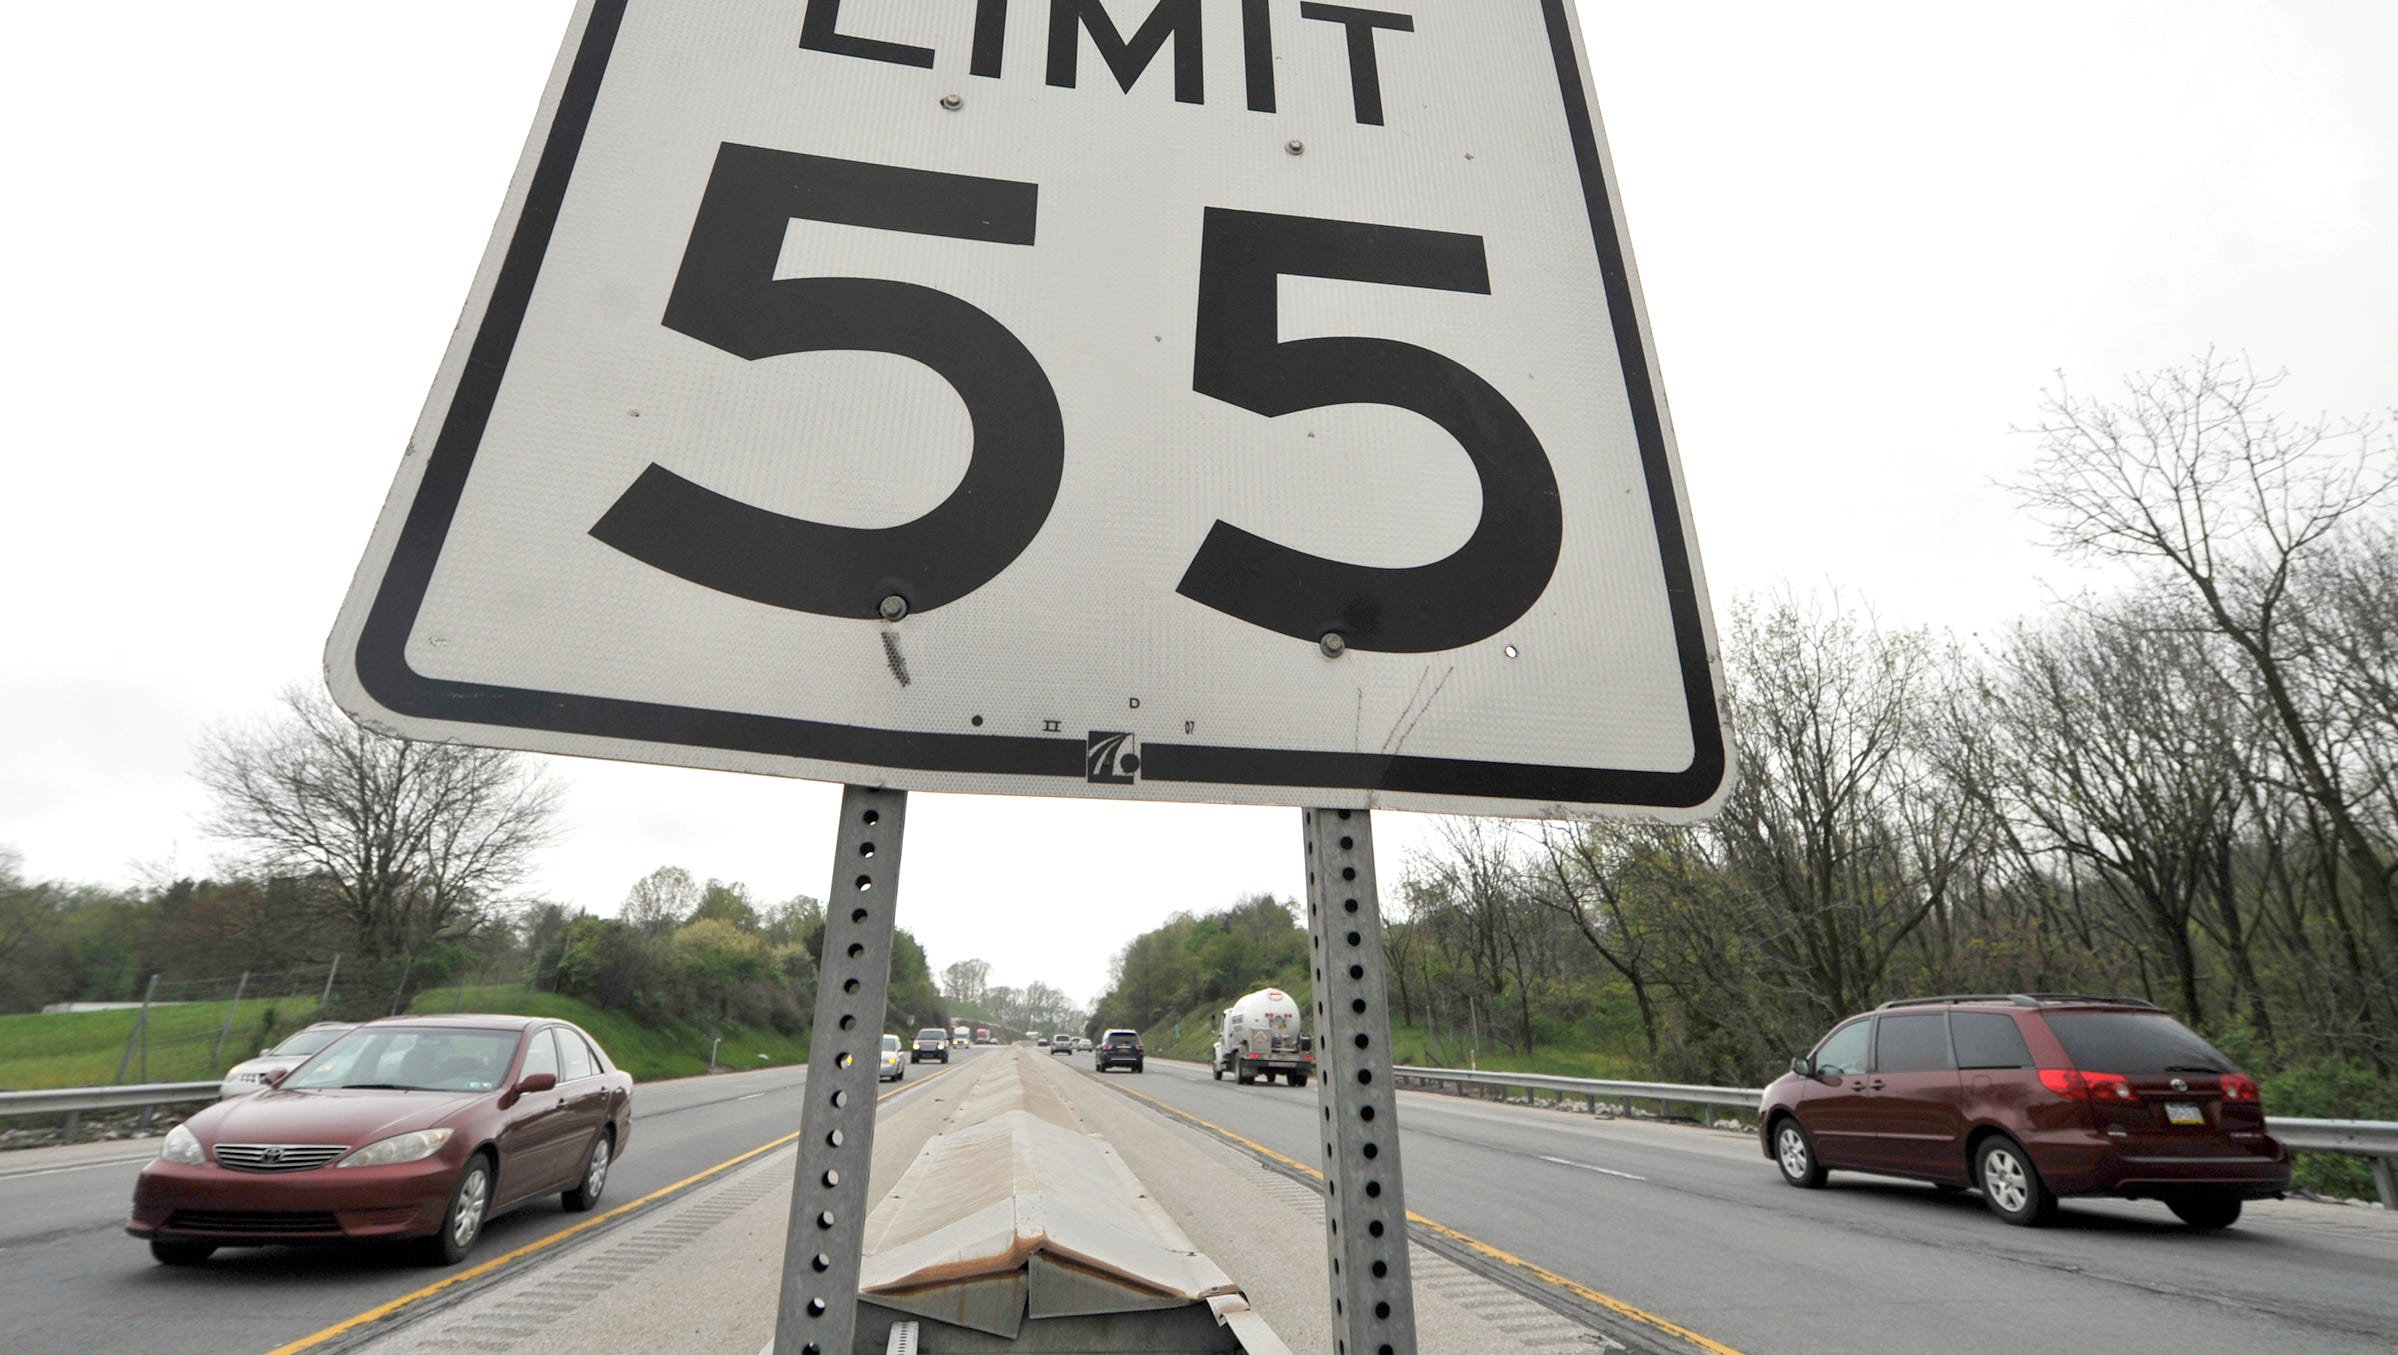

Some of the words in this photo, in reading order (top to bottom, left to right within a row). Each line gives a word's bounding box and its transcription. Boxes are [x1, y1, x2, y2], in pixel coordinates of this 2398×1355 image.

[799, 0, 1414, 126] LIMIT
[590, 142, 1562, 653] 55
[1129, 697, 1141, 709] D
[1184, 720, 1195, 735] 07
